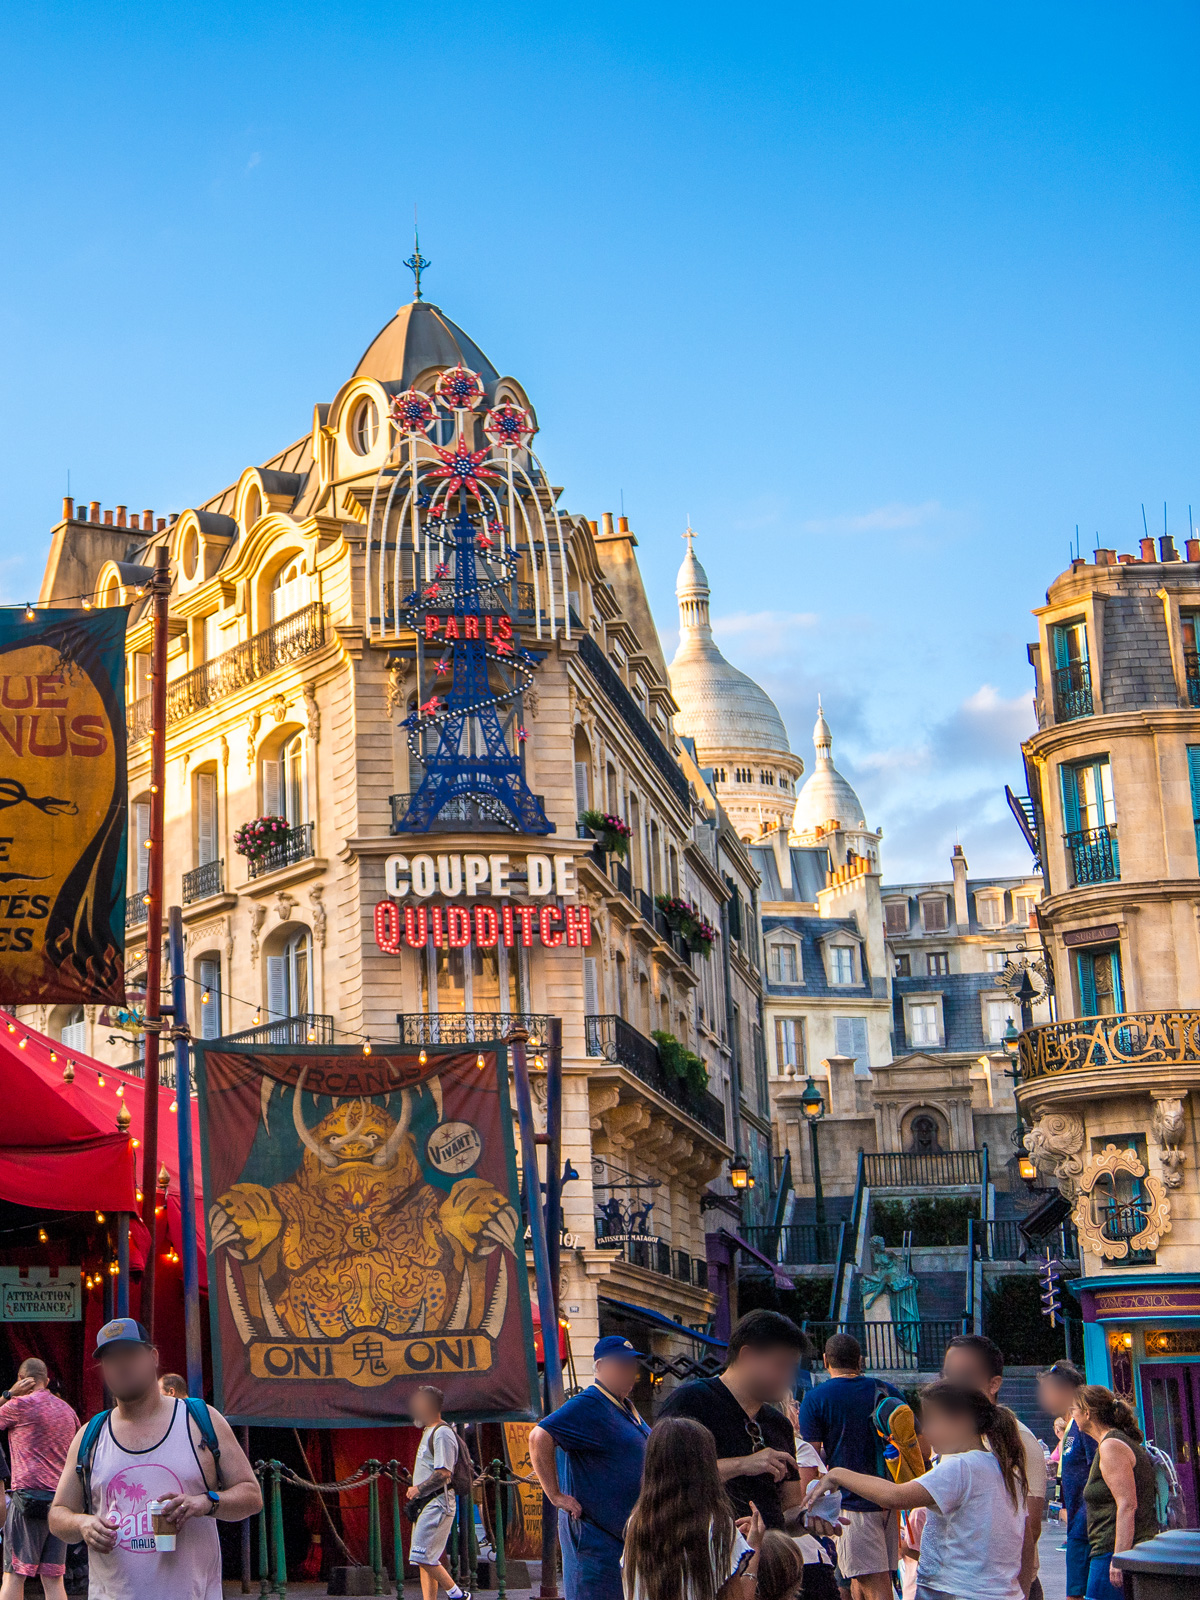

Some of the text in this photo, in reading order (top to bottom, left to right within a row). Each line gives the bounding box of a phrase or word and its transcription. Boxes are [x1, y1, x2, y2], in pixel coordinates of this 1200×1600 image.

[425, 614, 513, 640] PARIS
[385, 853, 575, 898] COUPE DE
[374, 900, 592, 955] QUIDDITCH
[282, 1062, 422, 1092] ARCANUS
[6, 1290, 71, 1301] ATTRACTION
[13, 1302, 66, 1312] ENTRANCE
[263, 1336, 477, 1378] ONI 鬼 ONI
[524, 1504, 542, 1516] CURIO
[131, 1538, 156, 1549] MALIB
